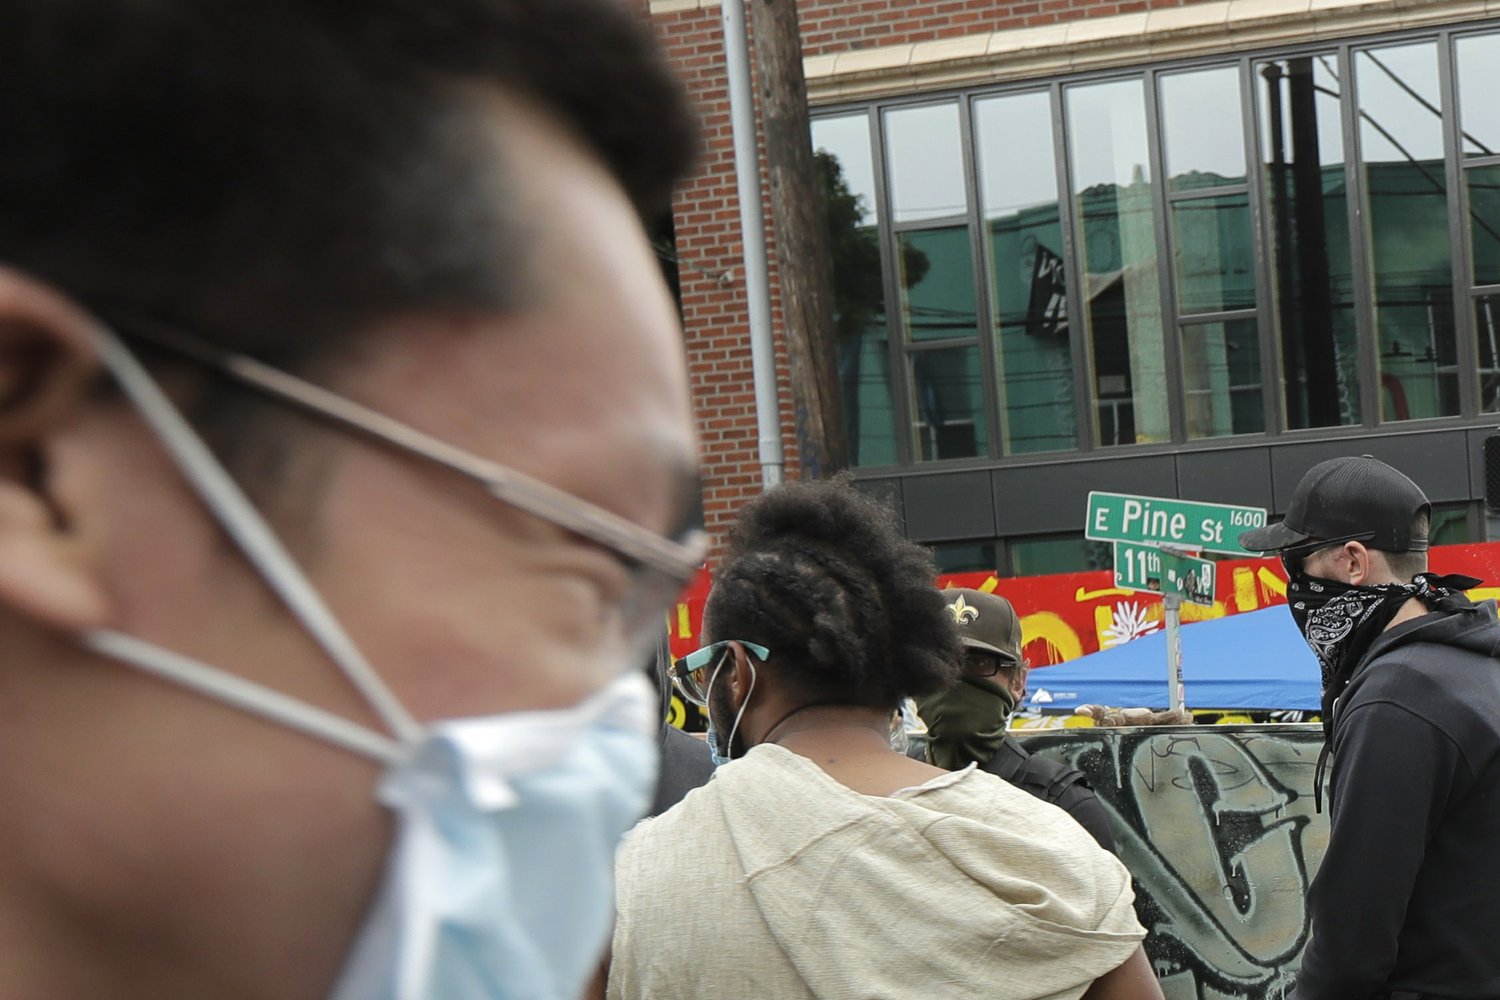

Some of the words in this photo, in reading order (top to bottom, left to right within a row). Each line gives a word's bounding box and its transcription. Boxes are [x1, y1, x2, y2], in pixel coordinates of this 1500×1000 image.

[1095, 507, 1110, 531] E
[1122, 500, 1186, 539] Pine
[1200, 518, 1223, 543] St
[1230, 510, 1262, 528] 1600
[1125, 549, 1160, 585] 11th
